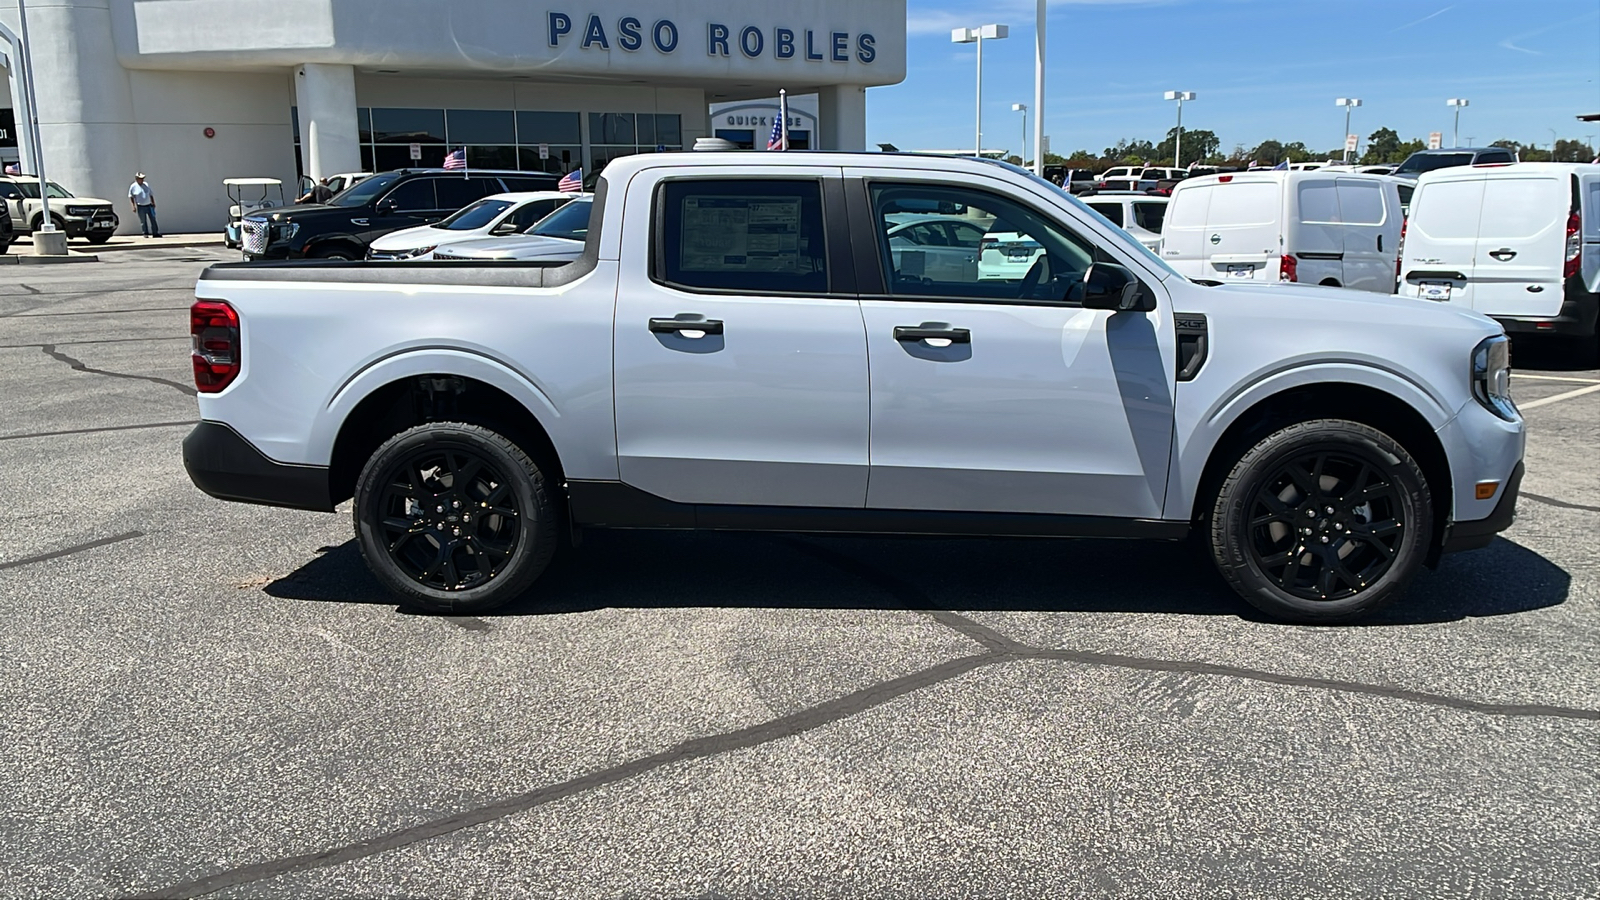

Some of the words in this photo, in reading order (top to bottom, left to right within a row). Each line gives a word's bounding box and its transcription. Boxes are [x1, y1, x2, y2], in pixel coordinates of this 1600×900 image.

[547, 10, 679, 54] PASO
[707, 22, 877, 65] ROBLES
[727, 115, 767, 126] QUICK
